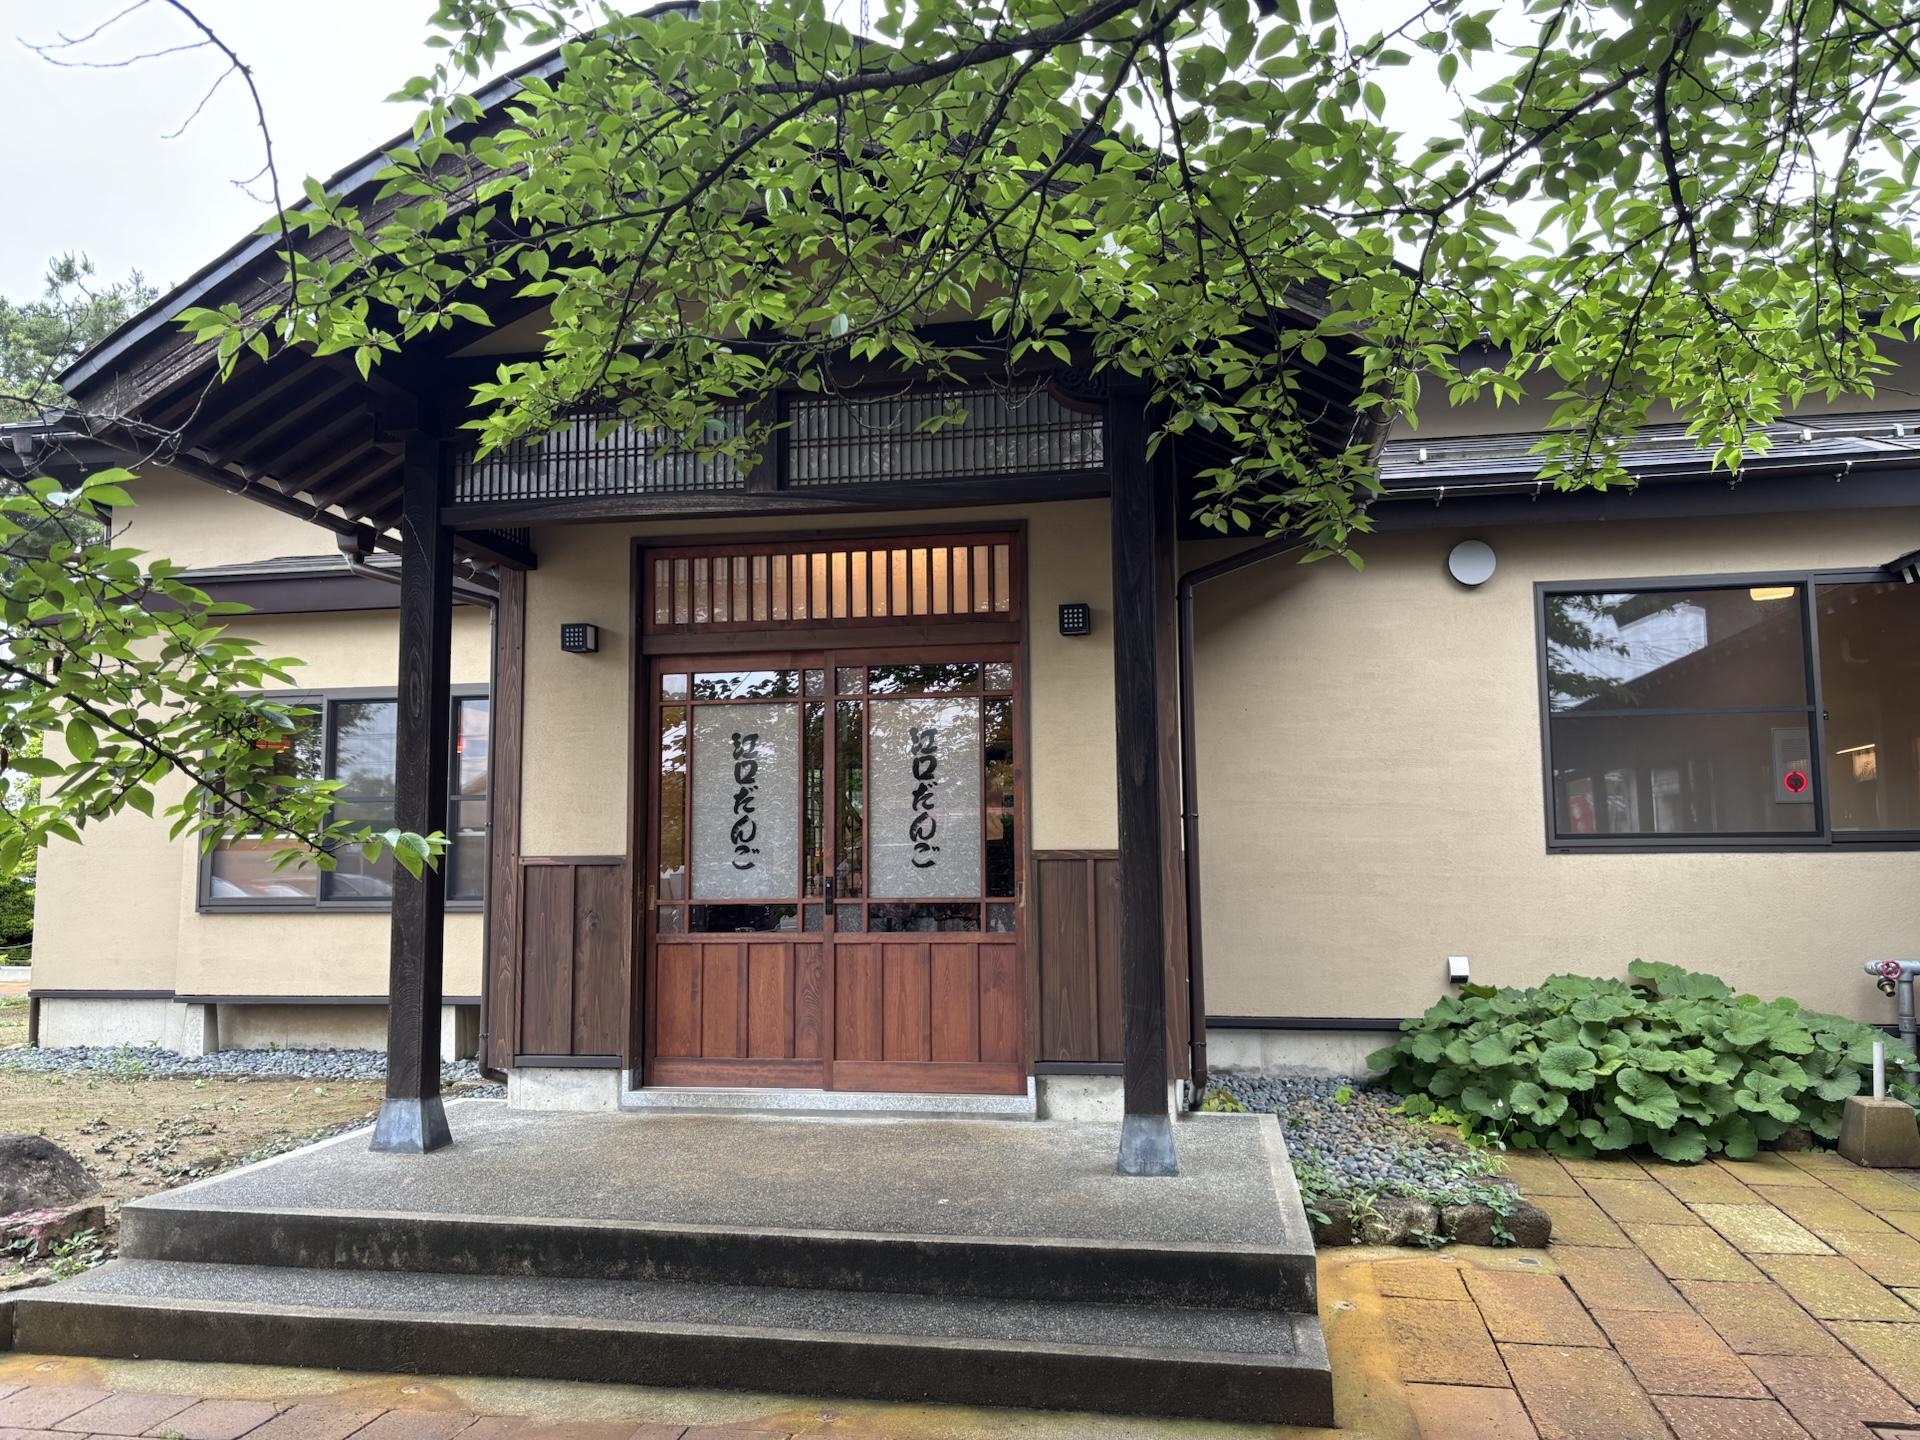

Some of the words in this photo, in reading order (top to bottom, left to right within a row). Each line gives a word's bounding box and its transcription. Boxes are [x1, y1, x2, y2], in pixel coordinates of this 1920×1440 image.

[730, 732, 760, 870] 江口だんご
[909, 727, 941, 868] 江口だんご
